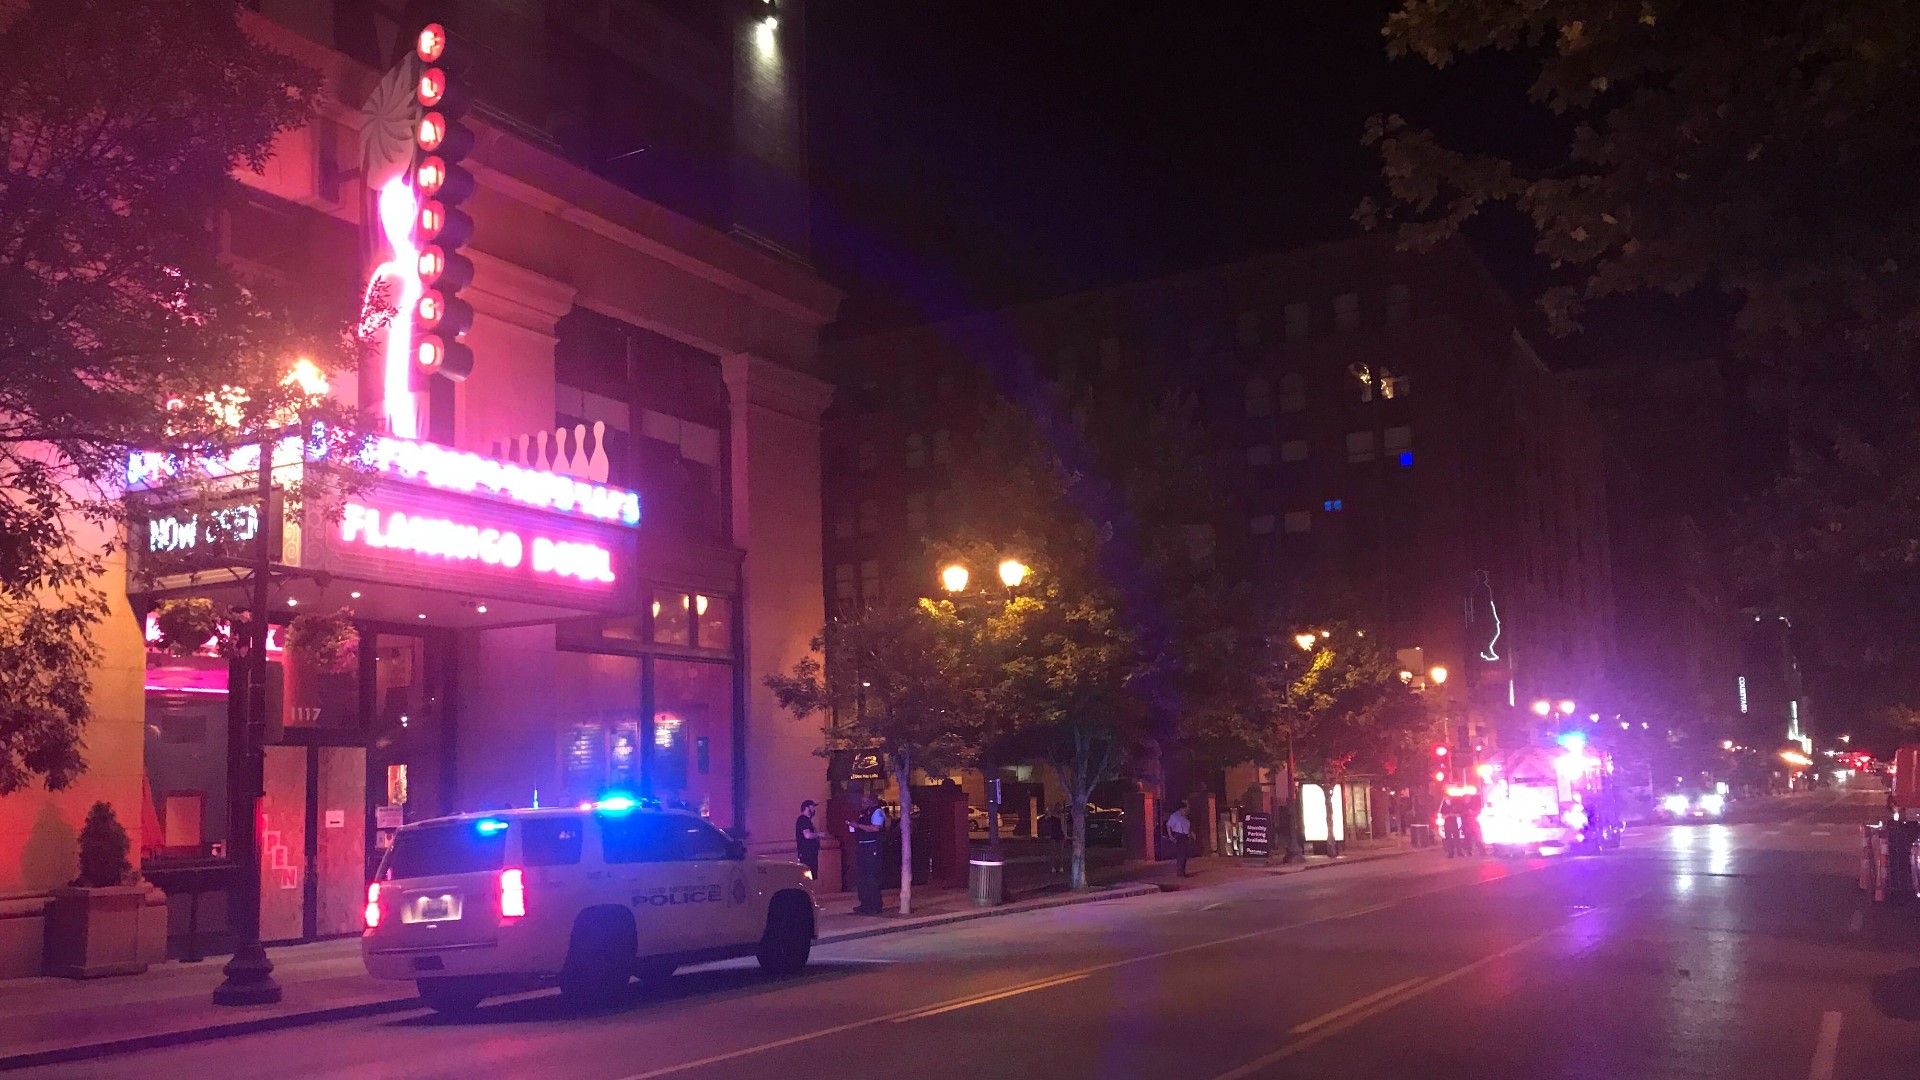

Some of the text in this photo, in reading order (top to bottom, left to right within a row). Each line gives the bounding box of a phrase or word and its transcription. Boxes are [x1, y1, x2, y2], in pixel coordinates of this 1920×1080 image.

[418, 26, 444, 370] FLAMINGO
[149, 513, 198, 552] NOW
[342, 502, 522, 567] FLAMINGO
[291, 706, 322, 721] 1117
[631, 890, 722, 907] POLICE
